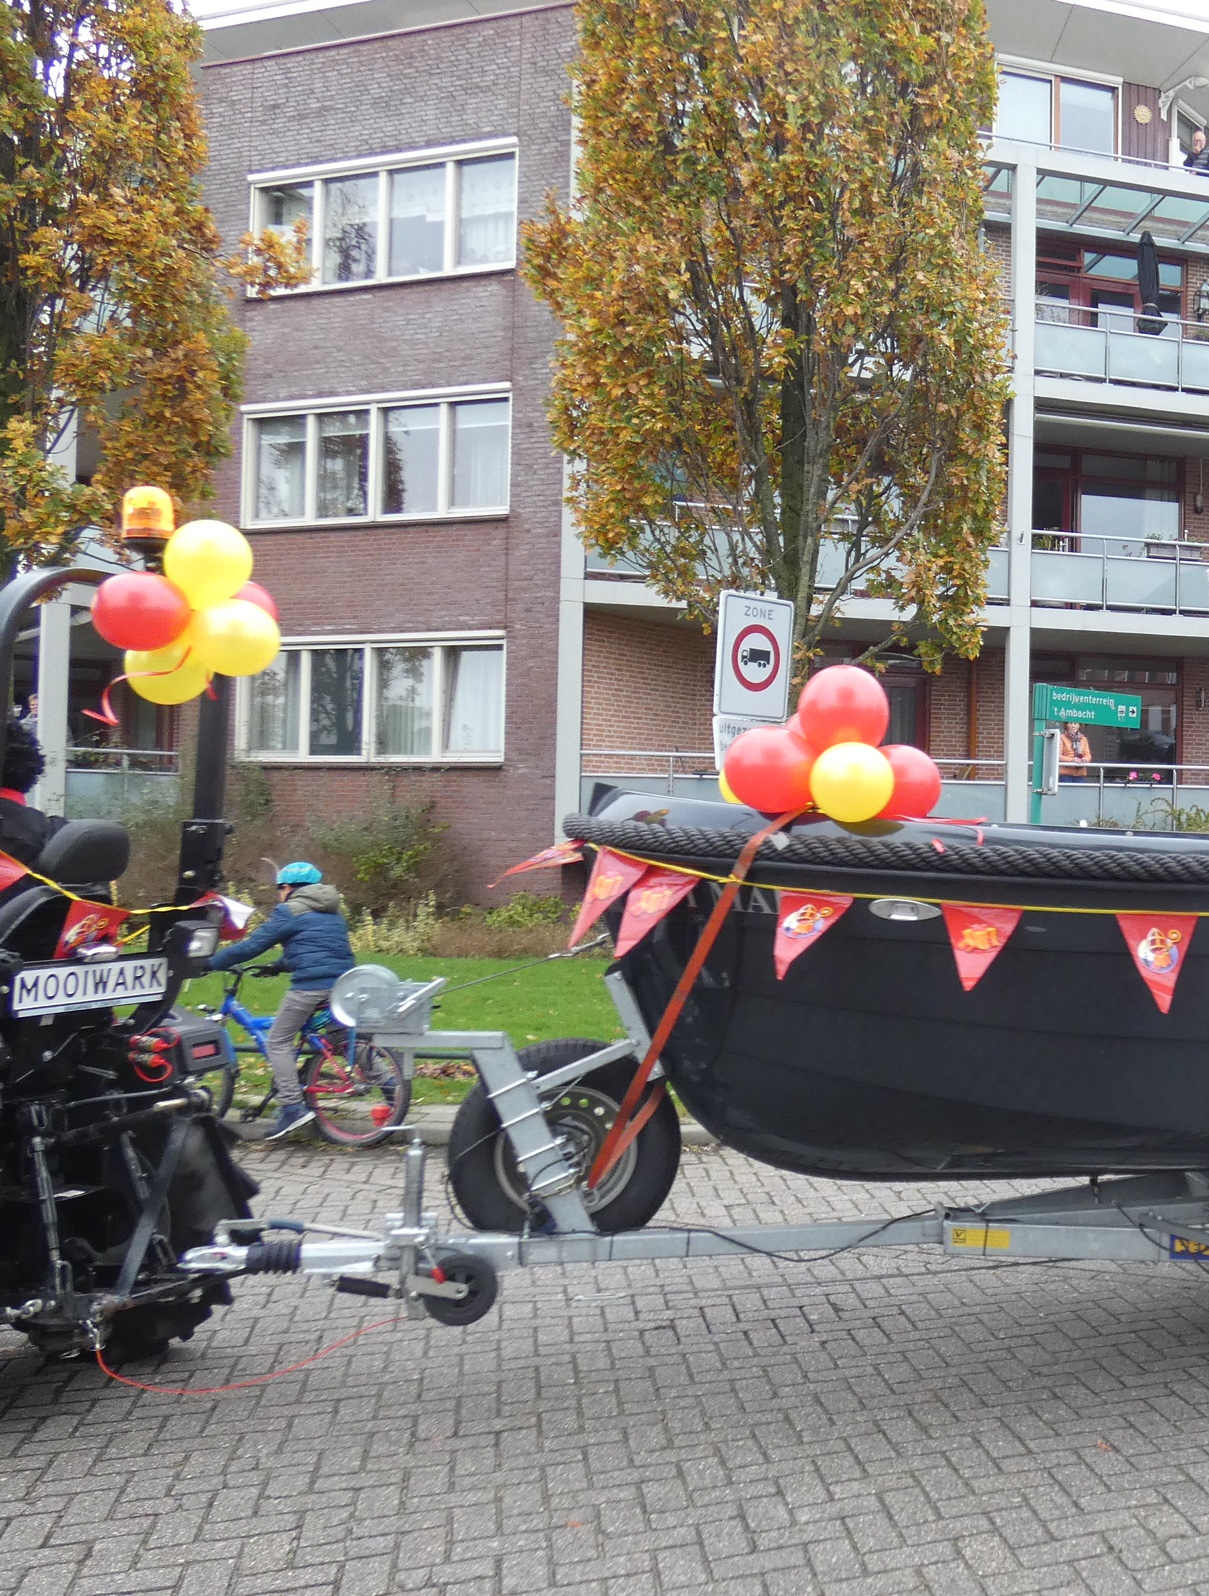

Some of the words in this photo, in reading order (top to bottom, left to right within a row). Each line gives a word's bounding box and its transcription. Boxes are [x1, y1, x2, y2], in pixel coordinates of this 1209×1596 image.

[744, 605, 774, 620] ZONE
[1052, 691, 1115, 706] bedrijventerrein
[1060, 707, 1095, 719] Ambacht
[719, 723, 752, 737] uitgez
[18, 962, 164, 1004] MOOIWARK
